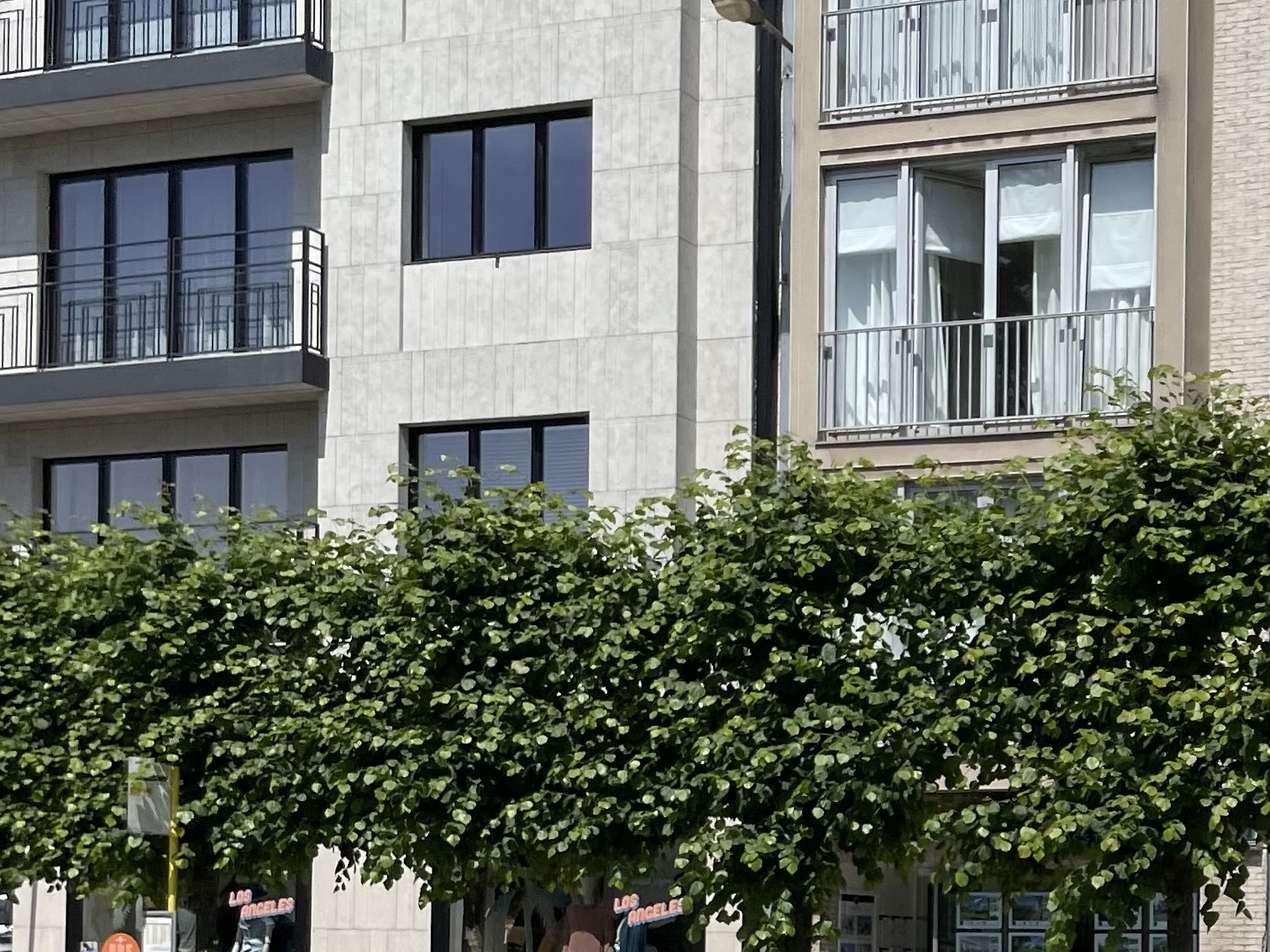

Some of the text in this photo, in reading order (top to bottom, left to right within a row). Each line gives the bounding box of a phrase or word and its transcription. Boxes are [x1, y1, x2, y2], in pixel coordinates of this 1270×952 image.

[229, 889, 253, 907] LOS
[240, 897, 294, 920] ANGELES
[613, 893, 640, 914] LOS
